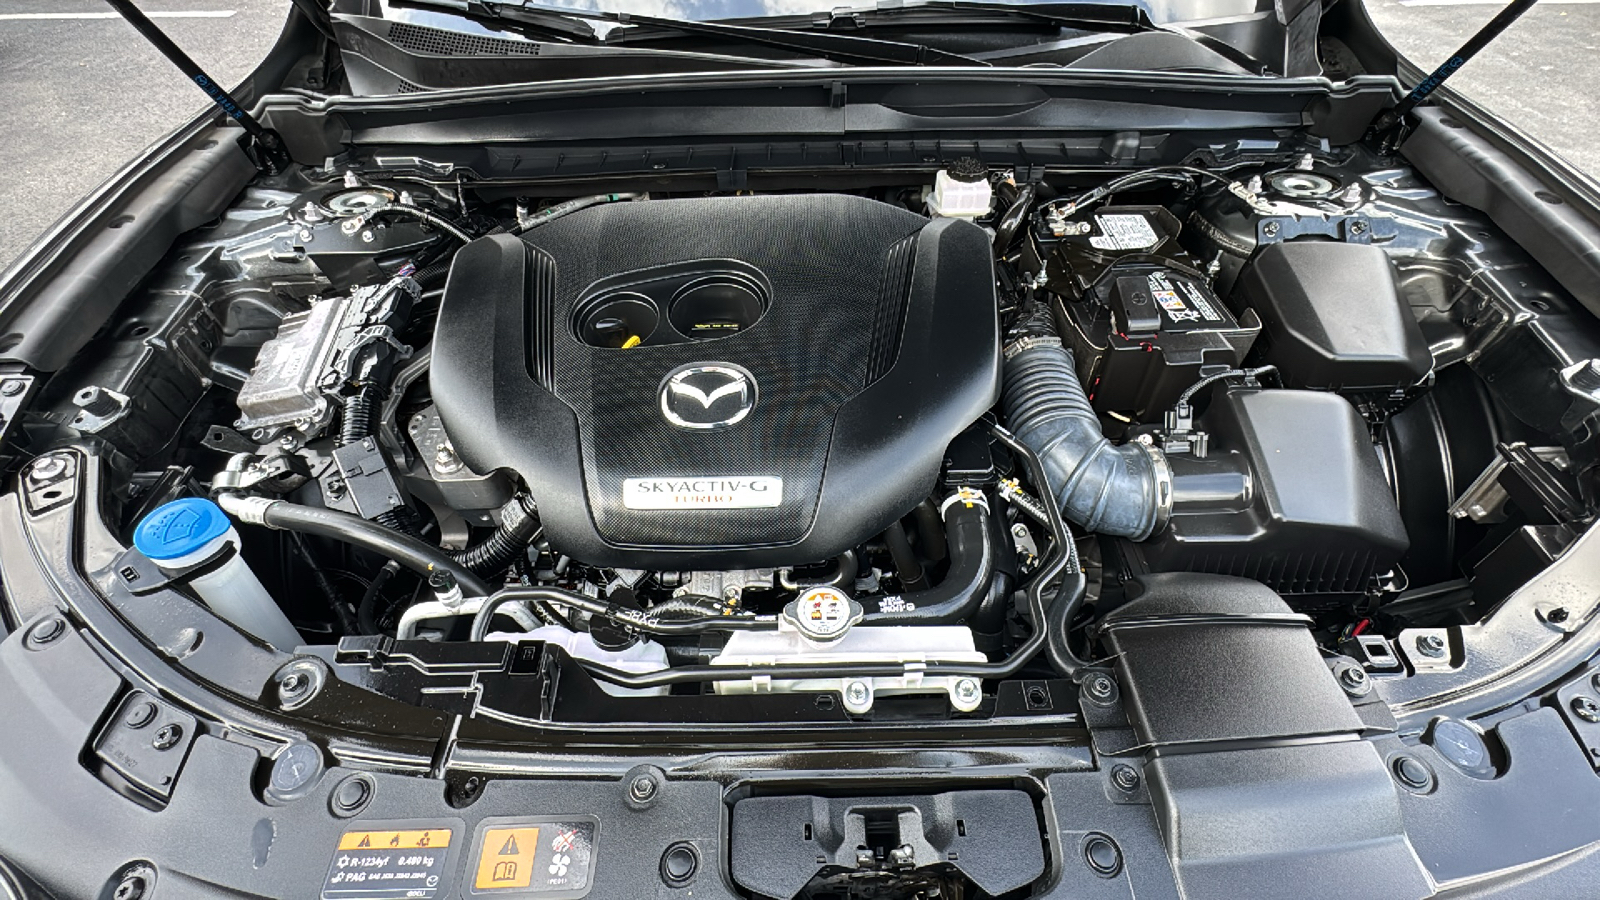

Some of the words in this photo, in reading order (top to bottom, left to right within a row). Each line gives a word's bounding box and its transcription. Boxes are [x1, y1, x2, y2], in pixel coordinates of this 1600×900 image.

[637, 480, 768, 493] SKYACTIV-G
[675, 495, 733, 503] TURBO
[350, 856, 391, 868] R-1234yf
[422, 856, 435, 867] kg
[345, 872, 367, 882] PAG
